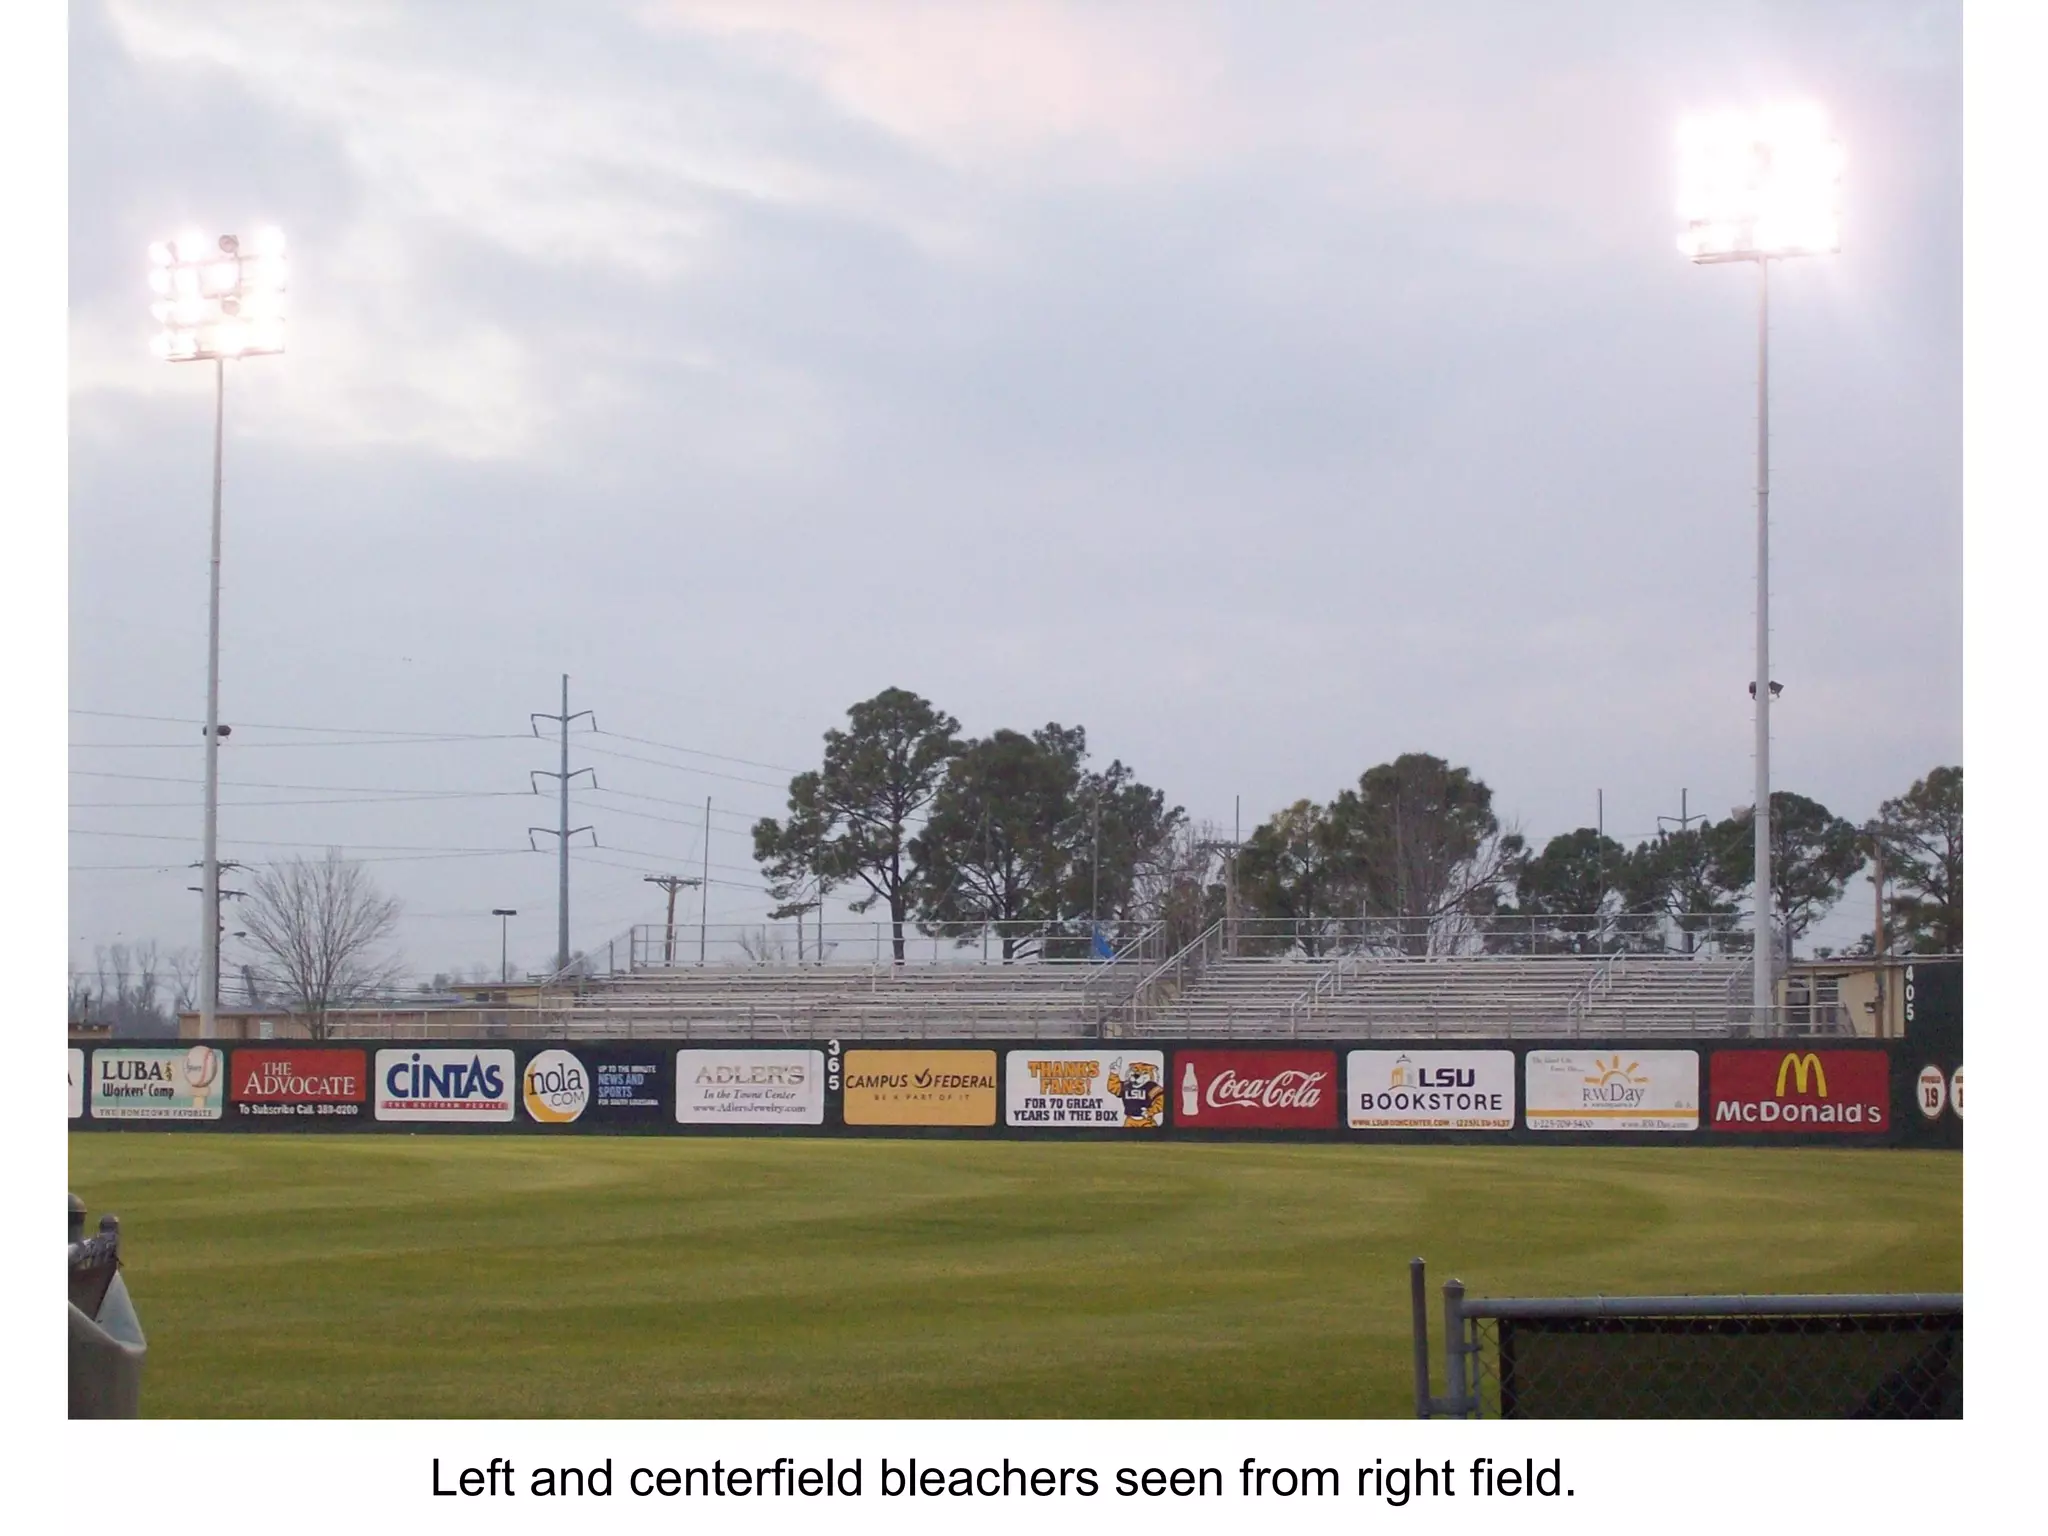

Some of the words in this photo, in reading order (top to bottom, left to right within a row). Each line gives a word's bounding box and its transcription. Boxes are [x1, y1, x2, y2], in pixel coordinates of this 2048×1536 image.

[102, 1060, 164, 1081] LUBA
[262, 1062, 292, 1075] THE
[827, 1039, 841, 1091] 365
[1028, 1060, 1100, 1078] THANKS
[243, 1071, 356, 1096] ADVOCATE
[527, 1062, 584, 1096] nola
[598, 1074, 624, 1085] NEWS
[625, 1074, 644, 1085] AND
[695, 1065, 805, 1085] ADLER'S
[845, 1075, 908, 1088] CAMPUS
[934, 1075, 995, 1088] FEDERAL
[1418, 1068, 1476, 1088] LSU
[102, 1082, 147, 1098] Workers'
[149, 1083, 175, 1100] Comp
[598, 1086, 633, 1098] SPORTS
[704, 1089, 714, 1099] In
[717, 1090, 731, 1099] the
[765, 1089, 796, 1099] Center
[1040, 1077, 1092, 1096] FANS!
[1125, 1090, 1147, 1100] LSU
[1205, 1069, 1328, 1108] Coca-Cola
[465, 1102, 503, 1110] PEOPLE
[1024, 1098, 1046, 1109] FOR
[1050, 1098, 1063, 1109] 70
[1066, 1098, 1104, 1109] GREAT
[1361, 1093, 1503, 1111] BOOKSTORE
[1925, 1087, 1939, 1109] 19
[239, 1104, 250, 1114] To
[252, 1104, 295, 1115] Subscribe
[1014, 1110, 1050, 1121] YEARS
[1053, 1110, 1066, 1121] IN
[1069, 1110, 1092, 1121] THE
[1095, 1110, 1118, 1121] BOX
[1715, 1101, 1882, 1123] McDonald's
